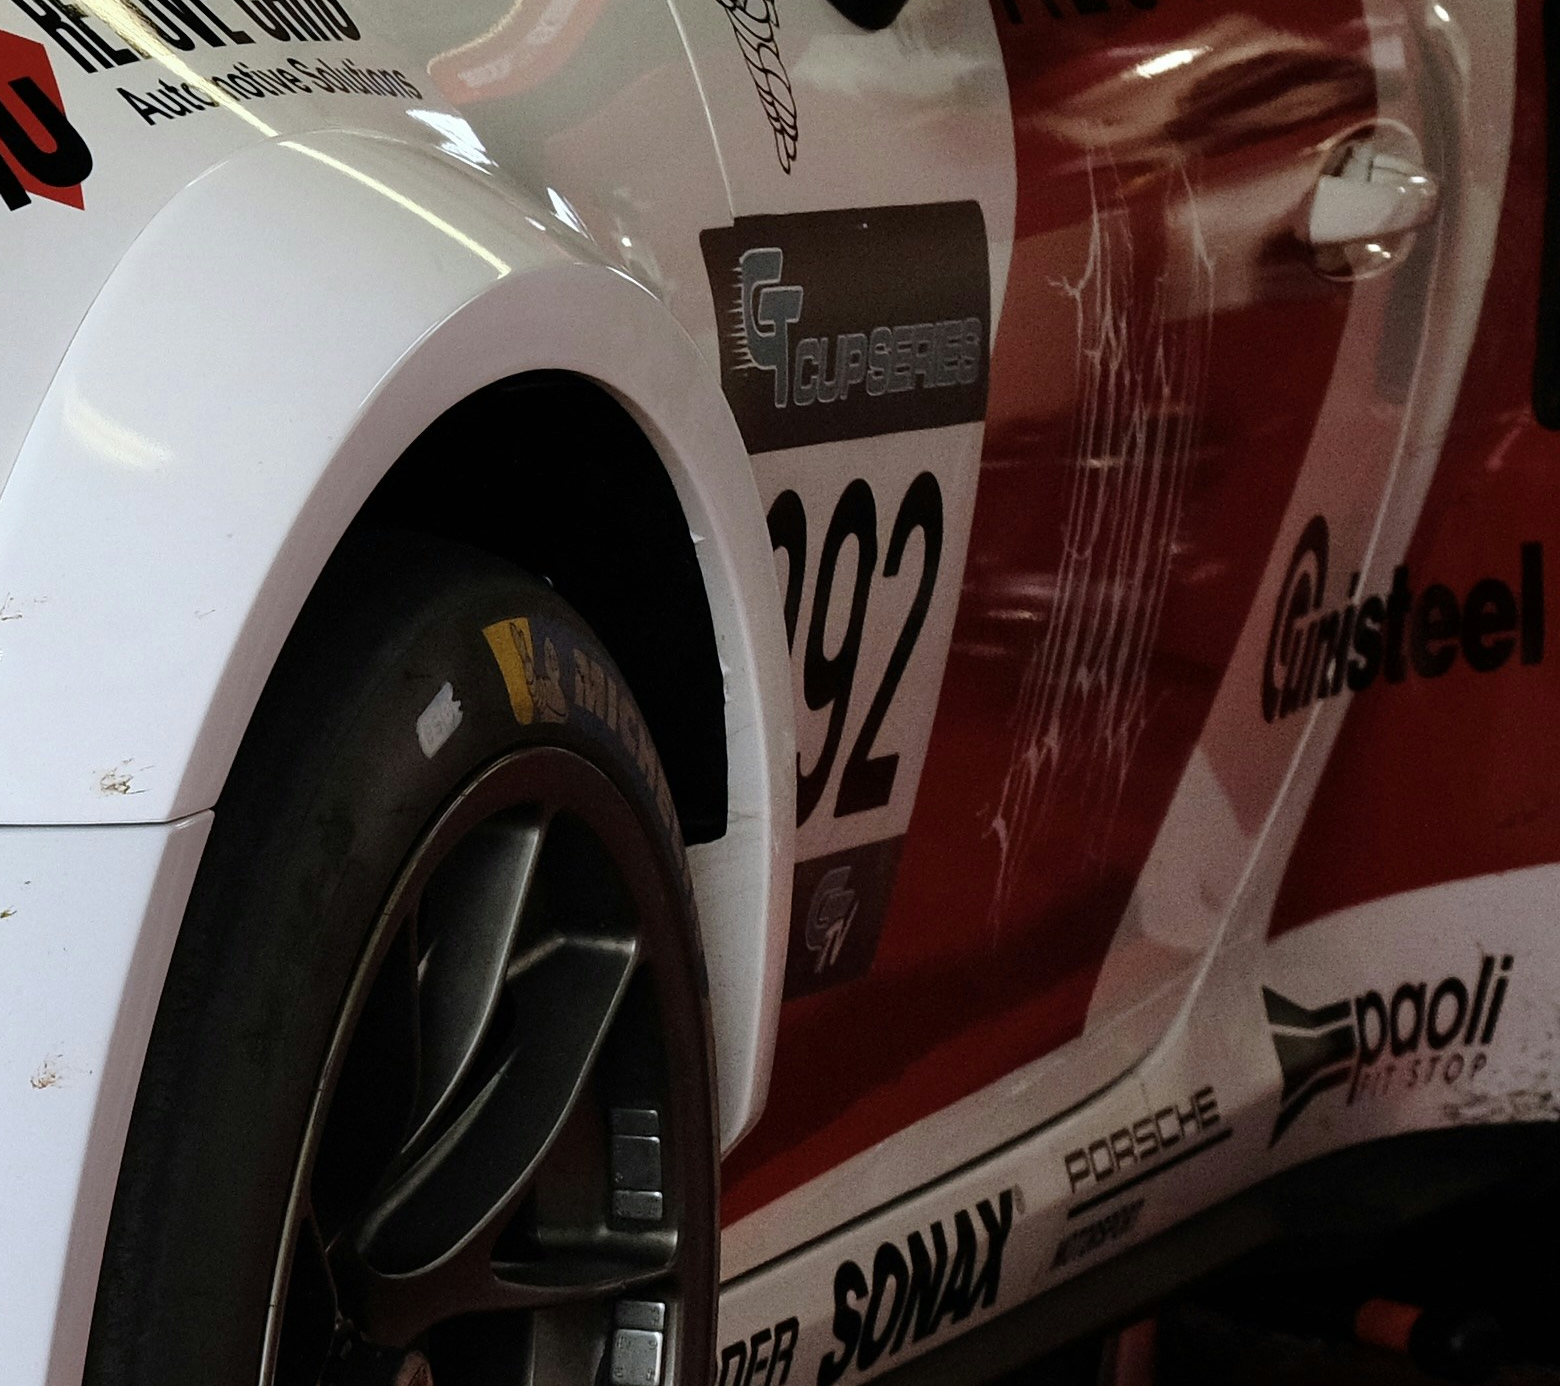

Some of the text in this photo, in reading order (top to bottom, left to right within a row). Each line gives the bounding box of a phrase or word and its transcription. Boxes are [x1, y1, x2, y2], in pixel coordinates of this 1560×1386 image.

[286, 56, 424, 101] Solutions
[1346, 953, 1515, 1107] paoli
[1406, 1051, 1488, 1089] STOP
[1064, 1085, 1222, 1195] PORSCHE
